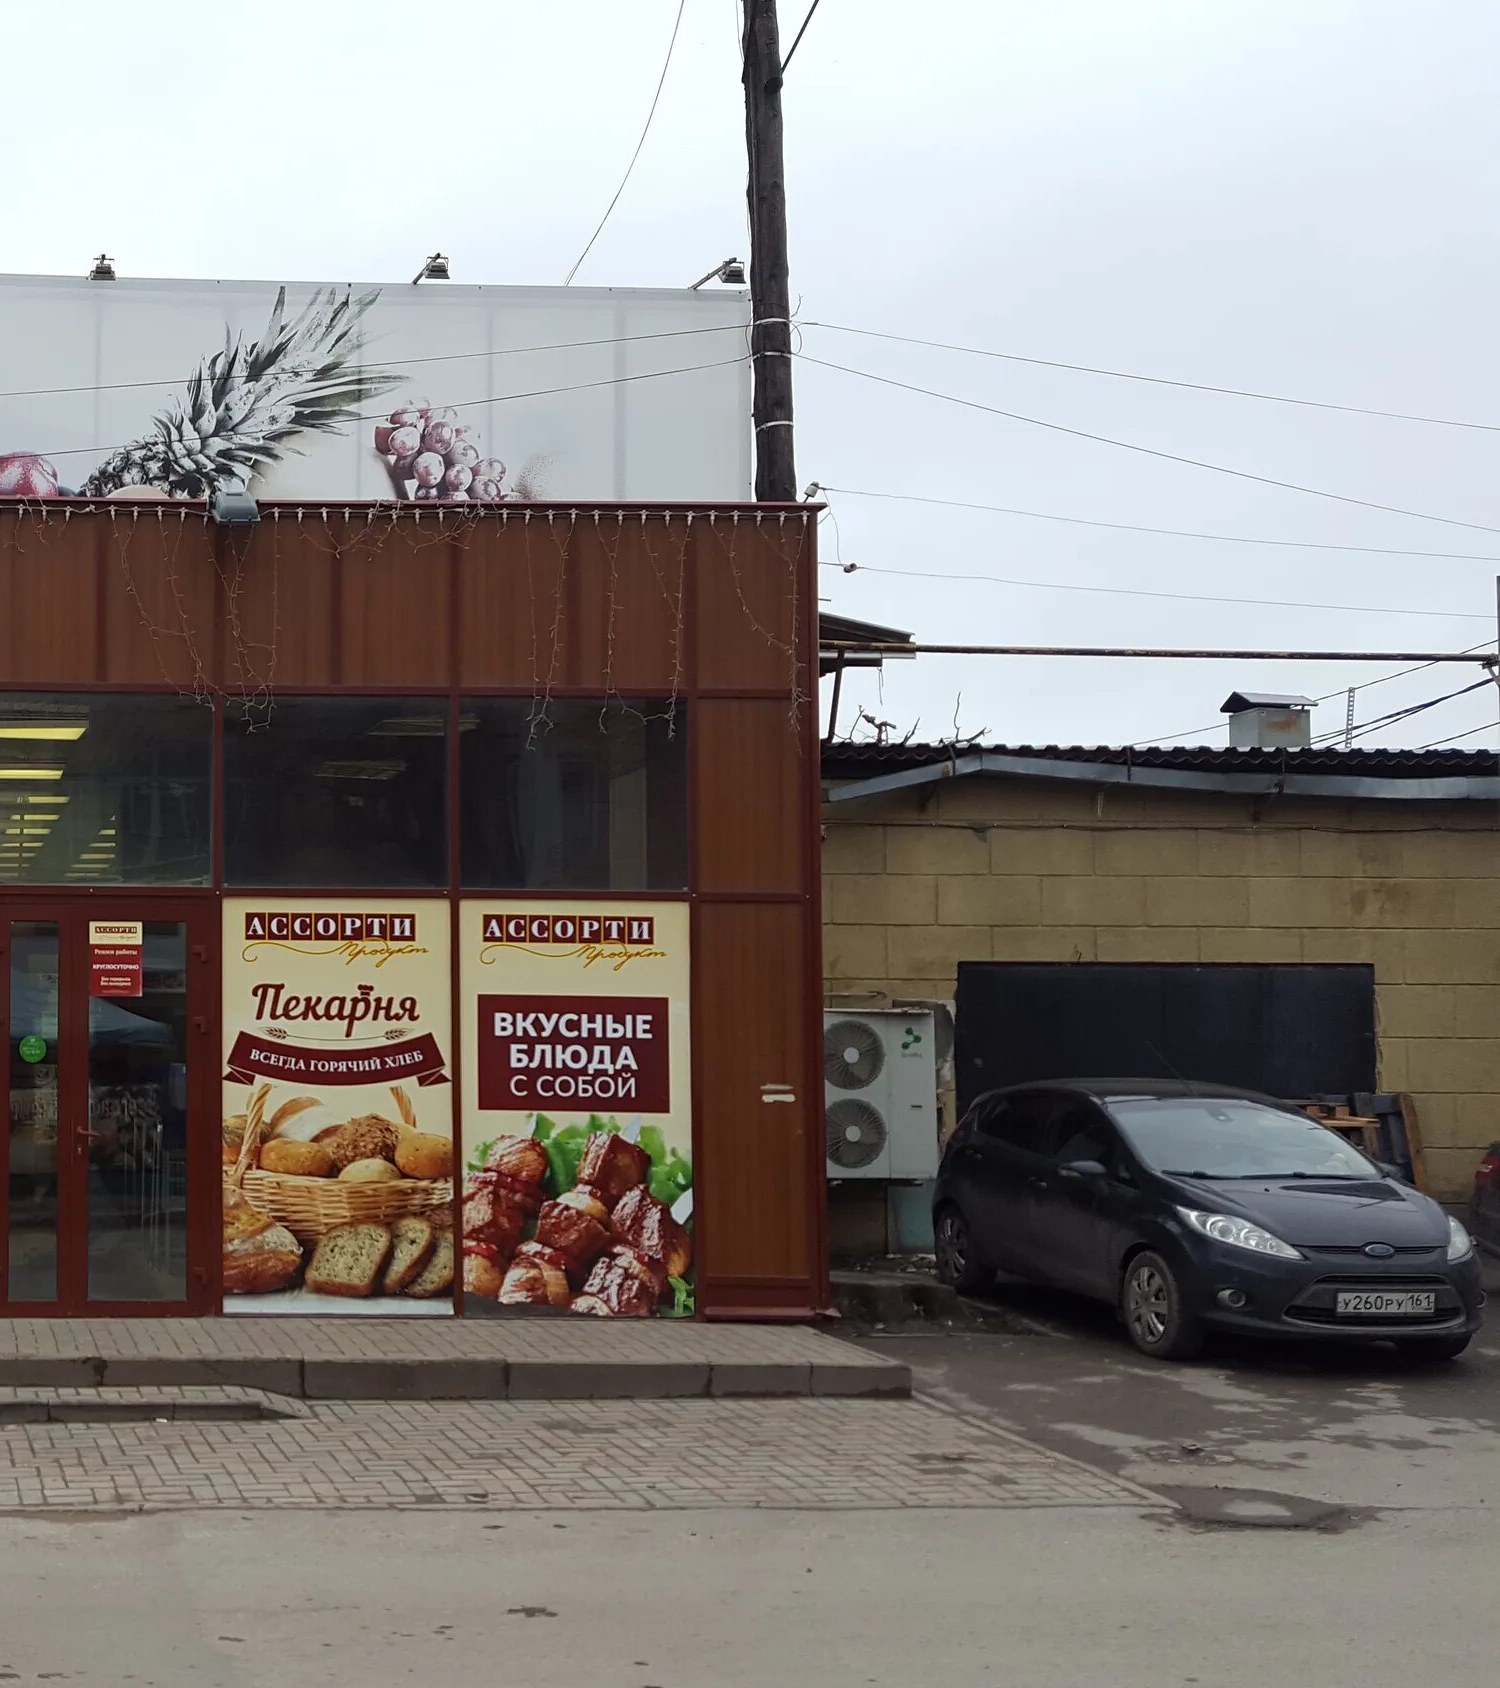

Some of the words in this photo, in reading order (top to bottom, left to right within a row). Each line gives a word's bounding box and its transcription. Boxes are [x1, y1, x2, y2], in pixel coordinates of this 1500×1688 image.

[246, 916, 413, 936] АССОРТИ
[484, 918, 651, 940] АССОРТИ
[251, 983, 420, 1038] Пекарня
[493, 1012, 653, 1040] ВКУСНЫЕ
[249, 1048, 307, 1072] ВСЕГДА
[308, 1055, 382, 1074] ГОРЯЧИЙ
[385, 1050, 424, 1069] ХЛЕБ
[509, 1044, 639, 1074] БЛЮДА
[509, 1075, 528, 1097] С
[536, 1072, 637, 1098] СОБОЙ
[1407, 1294, 1431, 1307] 161
